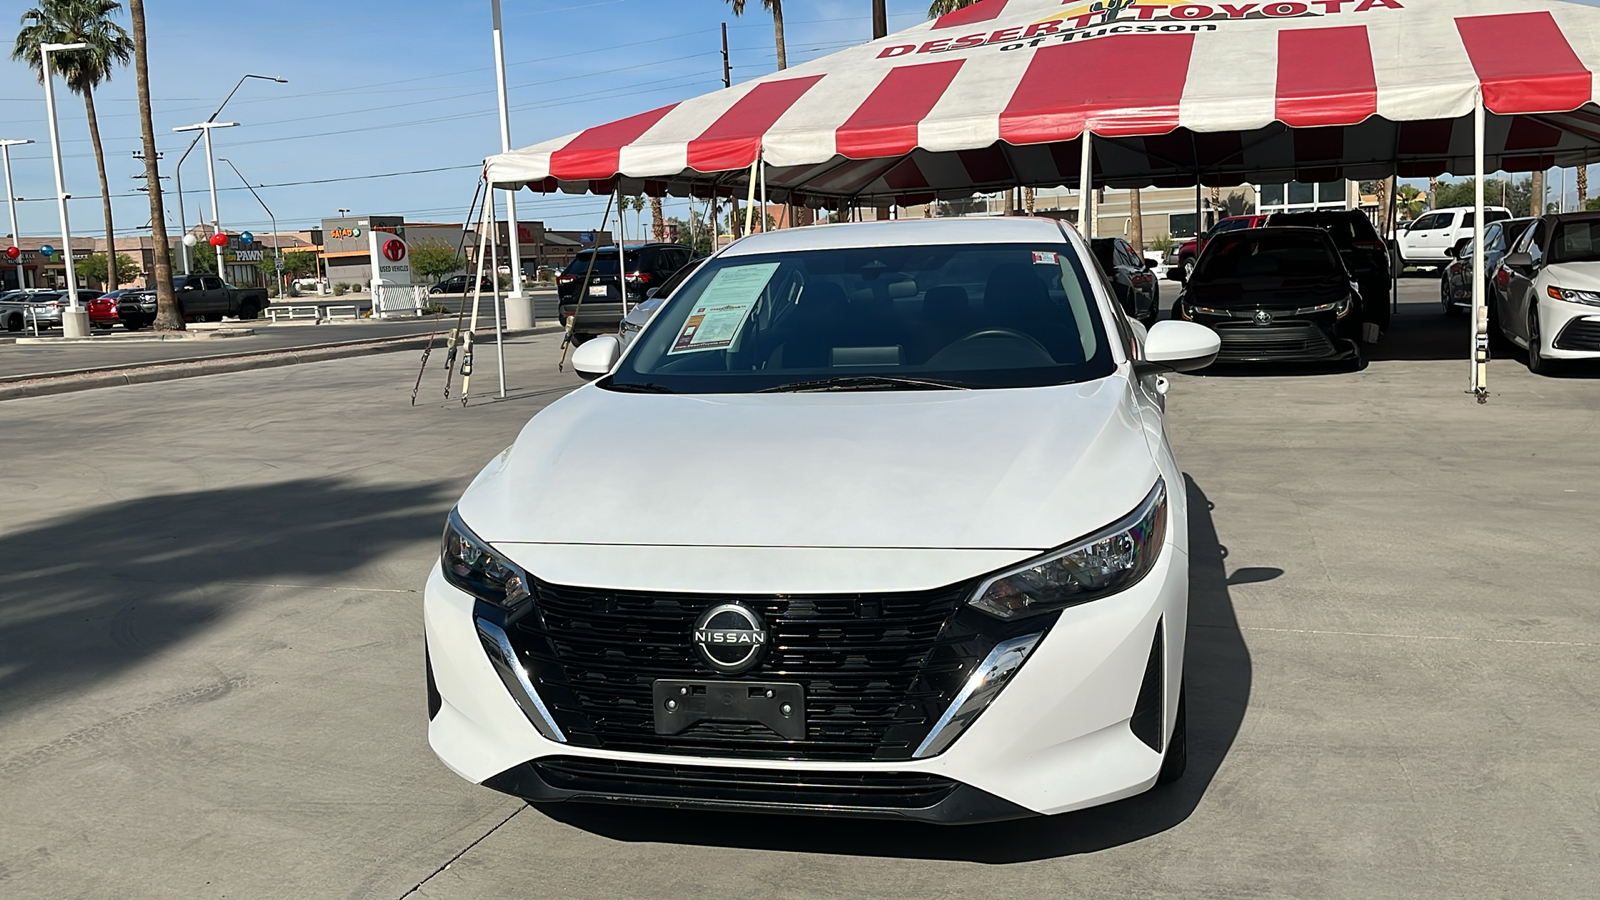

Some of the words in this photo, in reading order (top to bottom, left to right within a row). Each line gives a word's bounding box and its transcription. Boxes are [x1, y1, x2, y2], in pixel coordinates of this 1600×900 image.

[875, 11, 1105, 59] DESERT
[1128, 0, 1405, 20] TOYOTA
[999, 38, 1046, 52] of
[1055, 23, 1217, 42] Tucson
[330, 229, 353, 239] SALAD
[236, 250, 264, 261] PAWN
[695, 631, 764, 643] NISSAN
